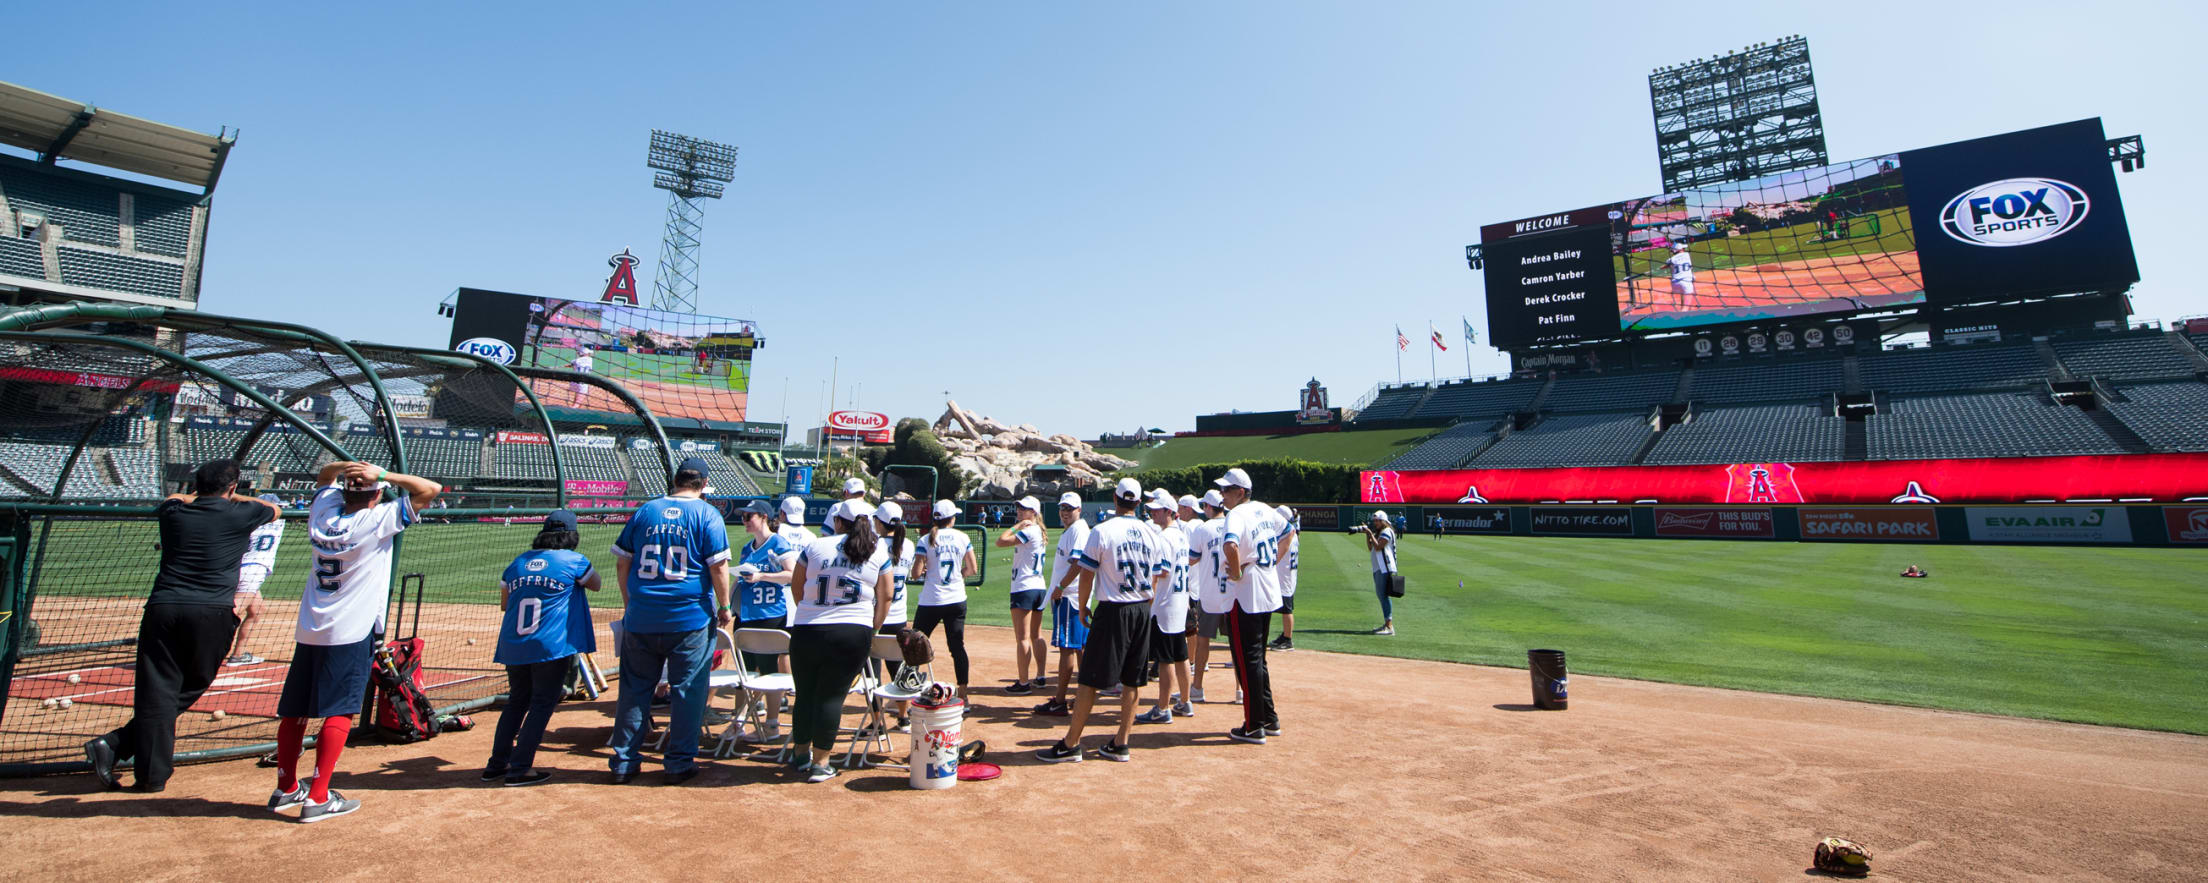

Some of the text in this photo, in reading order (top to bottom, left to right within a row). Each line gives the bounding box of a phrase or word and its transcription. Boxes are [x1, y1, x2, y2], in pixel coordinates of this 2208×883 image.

[1968, 187, 2056, 225] FOX
[1515, 214, 1570, 233] WELCOME
[1973, 215, 2059, 236] SPORTS
[1521, 249, 1581, 266] Andrea Bailey
[1521, 270, 1585, 286] Camron Yarber
[1525, 291, 1586, 306] Derek Crocker
[1538, 313, 1576, 325] Pat Finn
[1806, 331, 1820, 340] 42
[1836, 328, 1850, 338] 50
[1944, 326, 1977, 334] CLASSIC
[1750, 337, 1764, 346] 29
[1778, 334, 1792, 343] 30
[470, 343, 503, 358] FOX
[1520, 353, 1576, 368] Captain Morgan
[75, 372, 130, 389] ANGELS
[838, 414, 881, 426] Yakult
[1299, 510, 1336, 519] CHANGA
[1426, 514, 1493, 529] Termador
[1534, 514, 1629, 527] NITTO TIRE.COM
[1718, 511, 1770, 521] THIS BUD'S
[1985, 517, 2075, 527] EVA AIR
[645, 523, 689, 540] CAPERS
[1719, 521, 1762, 531] FOR YOU.
[1806, 521, 1931, 536] SAFARI PARK
[638, 543, 688, 581] 60
[316, 556, 343, 593] 2
[940, 559, 955, 585] 7
[508, 574, 565, 593] JEFFRIES
[816, 574, 862, 606] 13
[752, 586, 776, 604] 32
[516, 597, 542, 636] 0
